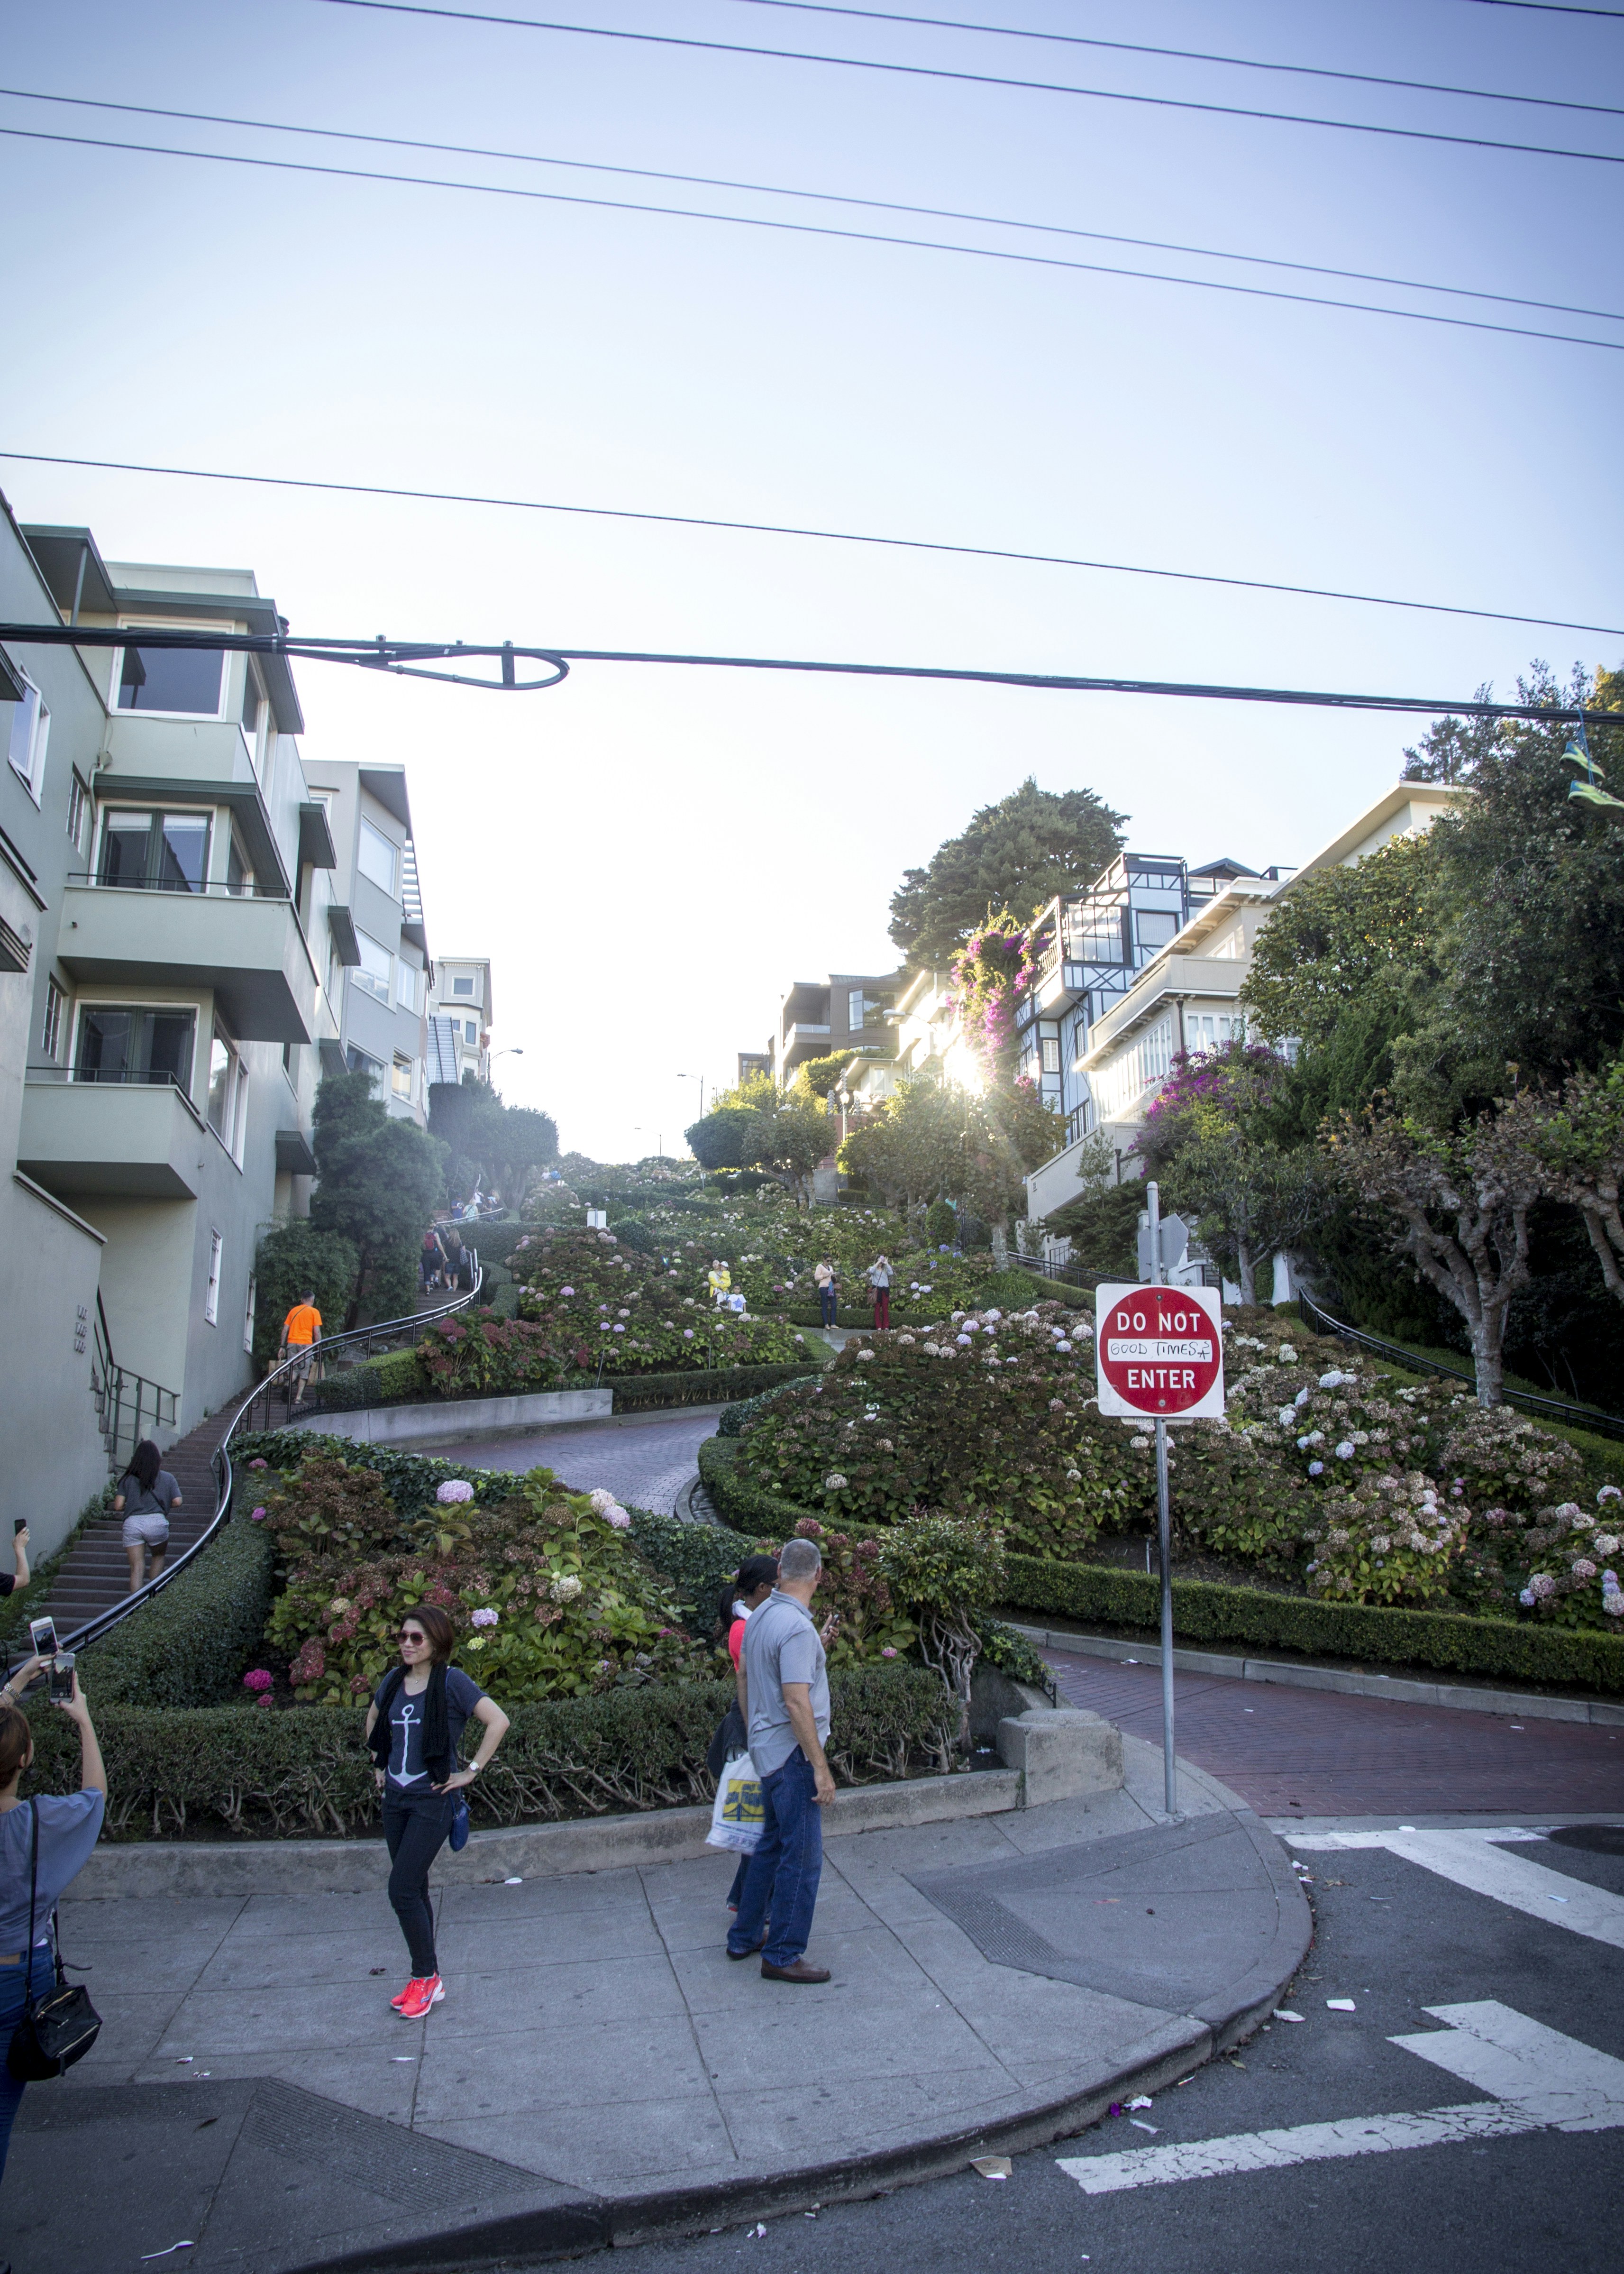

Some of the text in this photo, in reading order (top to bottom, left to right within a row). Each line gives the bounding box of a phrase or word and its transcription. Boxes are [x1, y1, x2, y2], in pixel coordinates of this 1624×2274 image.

[1117, 1312, 1200, 1331] DO NOT
[1111, 1343, 1147, 1355] GOOD
[1128, 1369, 1195, 1388] ENTER
